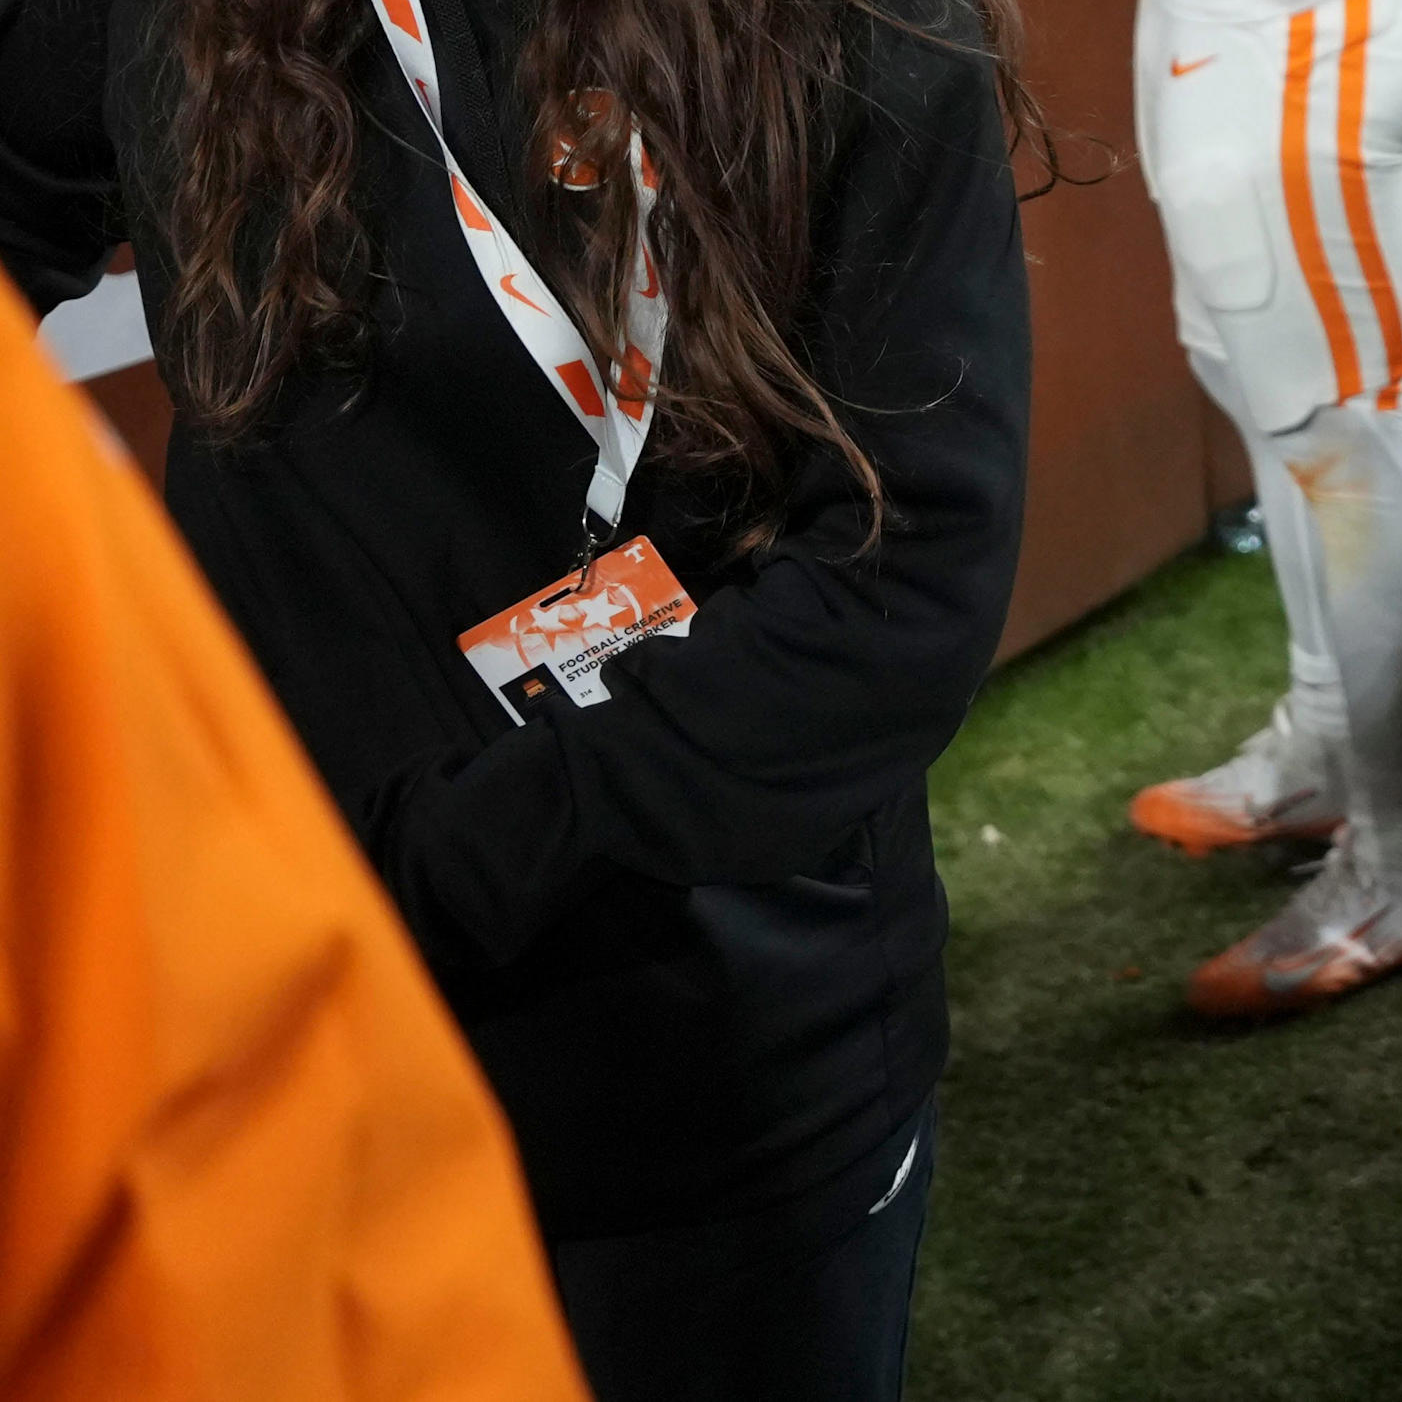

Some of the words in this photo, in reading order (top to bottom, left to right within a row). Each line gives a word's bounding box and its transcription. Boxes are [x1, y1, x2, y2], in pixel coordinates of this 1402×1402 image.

[624, 543, 646, 564] T
[558, 634, 623, 673] FOOTBALL
[624, 598, 683, 636] CREATIVE
[566, 646, 621, 682] STUDENT
[623, 615, 678, 649] WORKER
